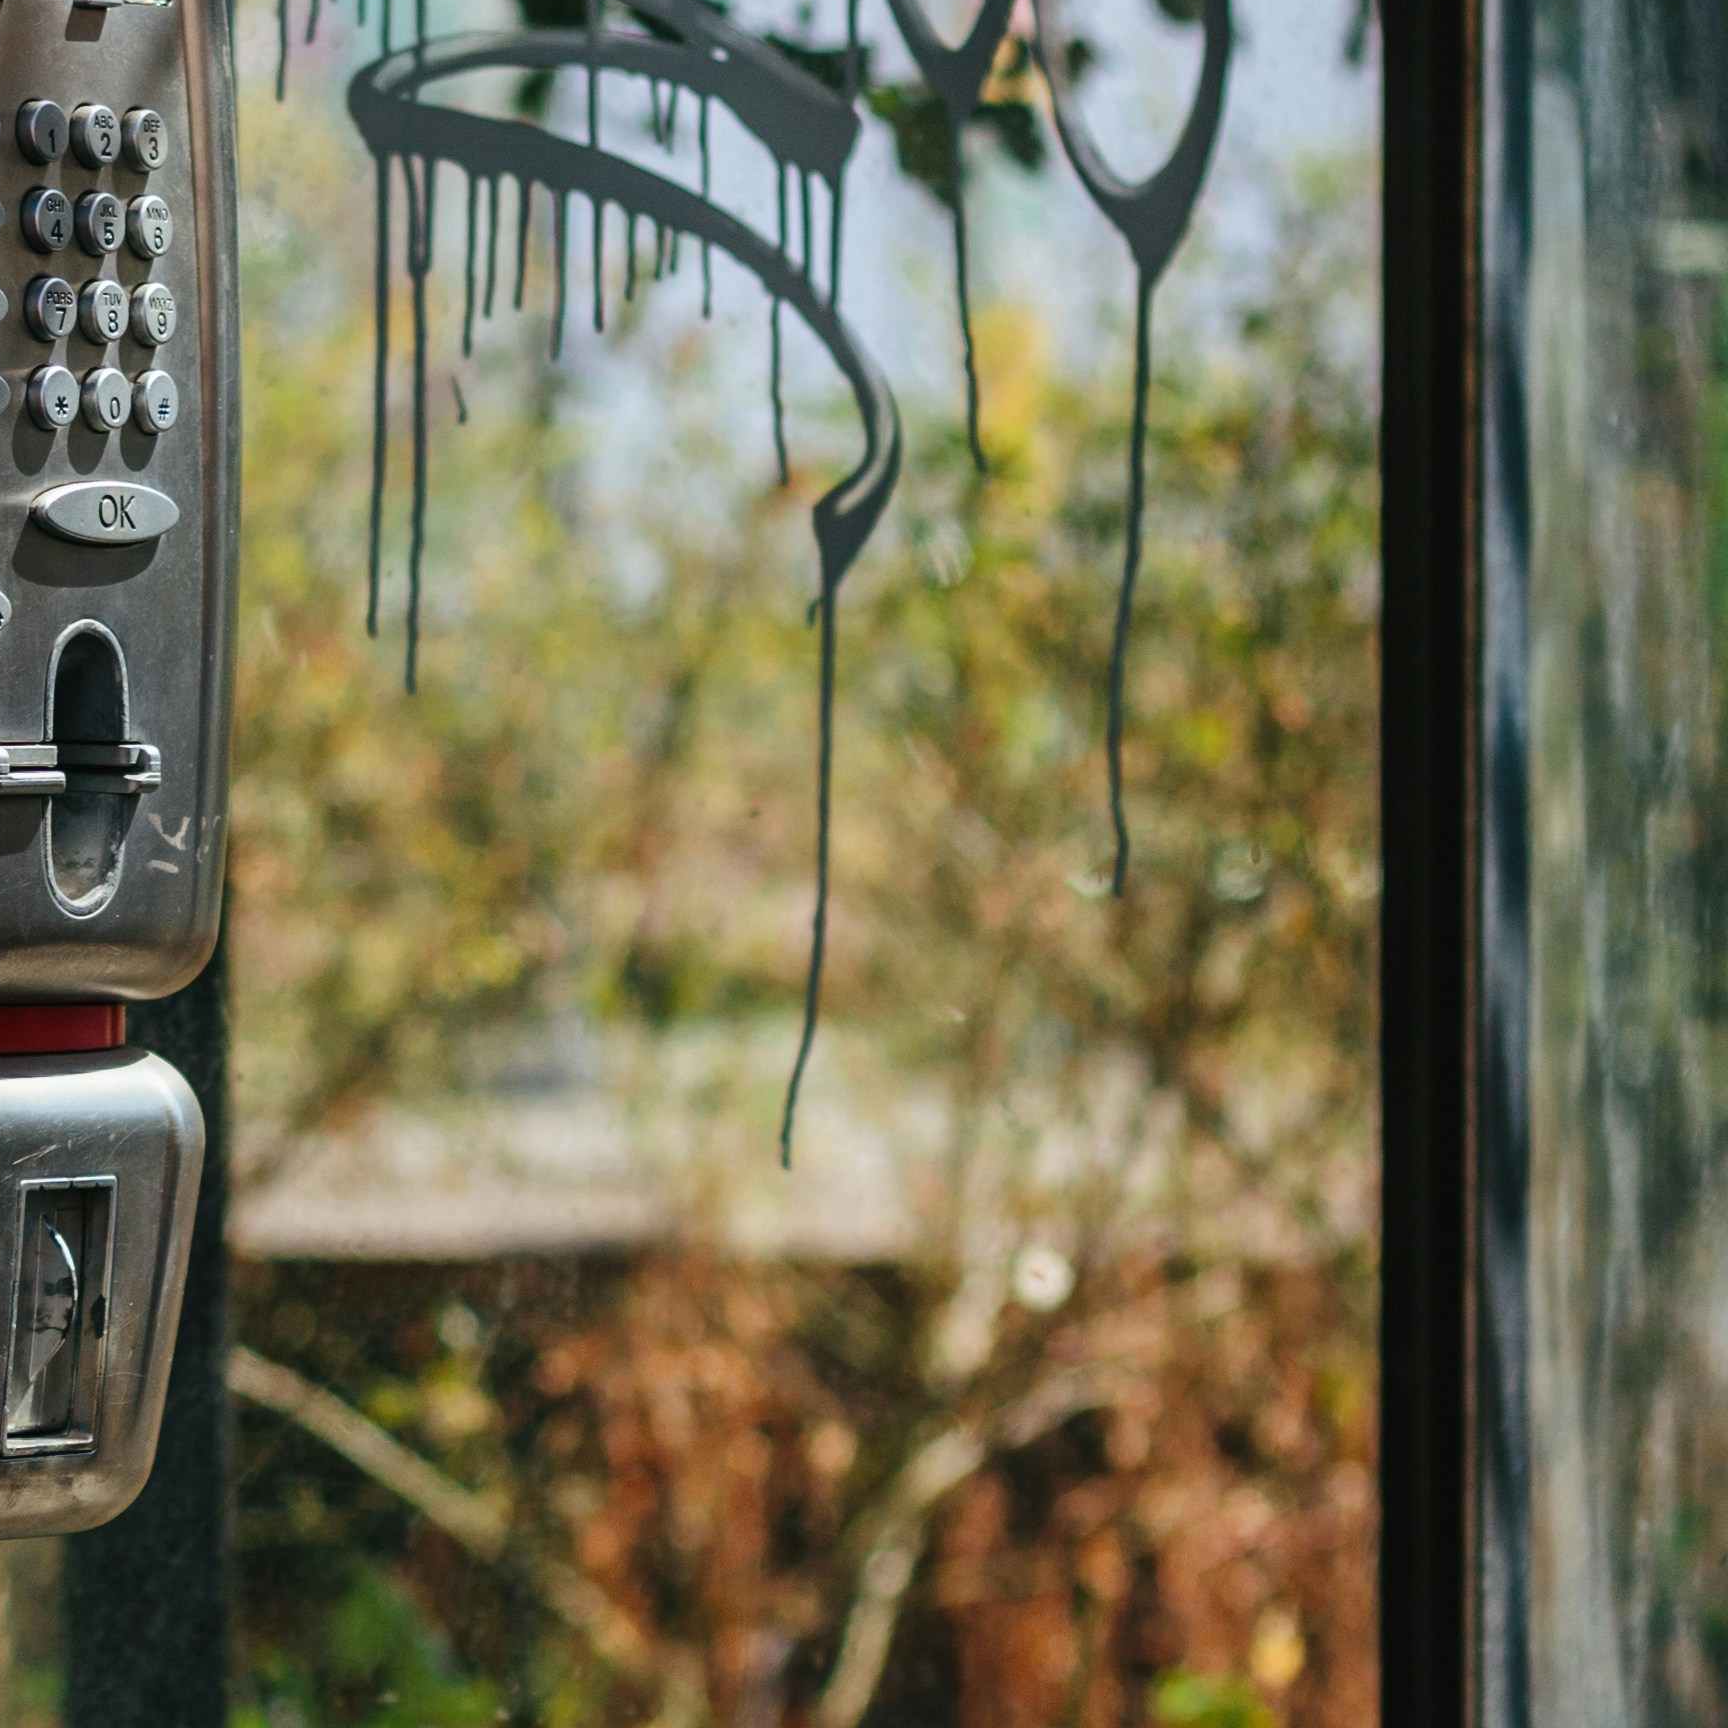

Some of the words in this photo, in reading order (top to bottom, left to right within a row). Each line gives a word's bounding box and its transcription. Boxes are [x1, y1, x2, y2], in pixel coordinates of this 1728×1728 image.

[93, 114, 115, 130] ABC
[142, 118, 161, 133] DEF
[48, 128, 56, 154] 1
[100, 132, 113, 158] 2
[148, 137, 159, 161] 3
[45, 198, 65, 213] GHI
[99, 203, 118, 219] JKL
[146, 207, 169, 220] MNO
[51, 219, 64, 244] 4
[103, 222, 115, 246] 5
[154, 226, 164, 250] 6
[46, 291, 74, 306] PQRS
[102, 292, 123, 307] TUV
[55, 306, 67, 332] 7
[108, 309, 119, 334] 8
[157, 311, 168, 335] 9
[98, 494, 136, 530] OK
